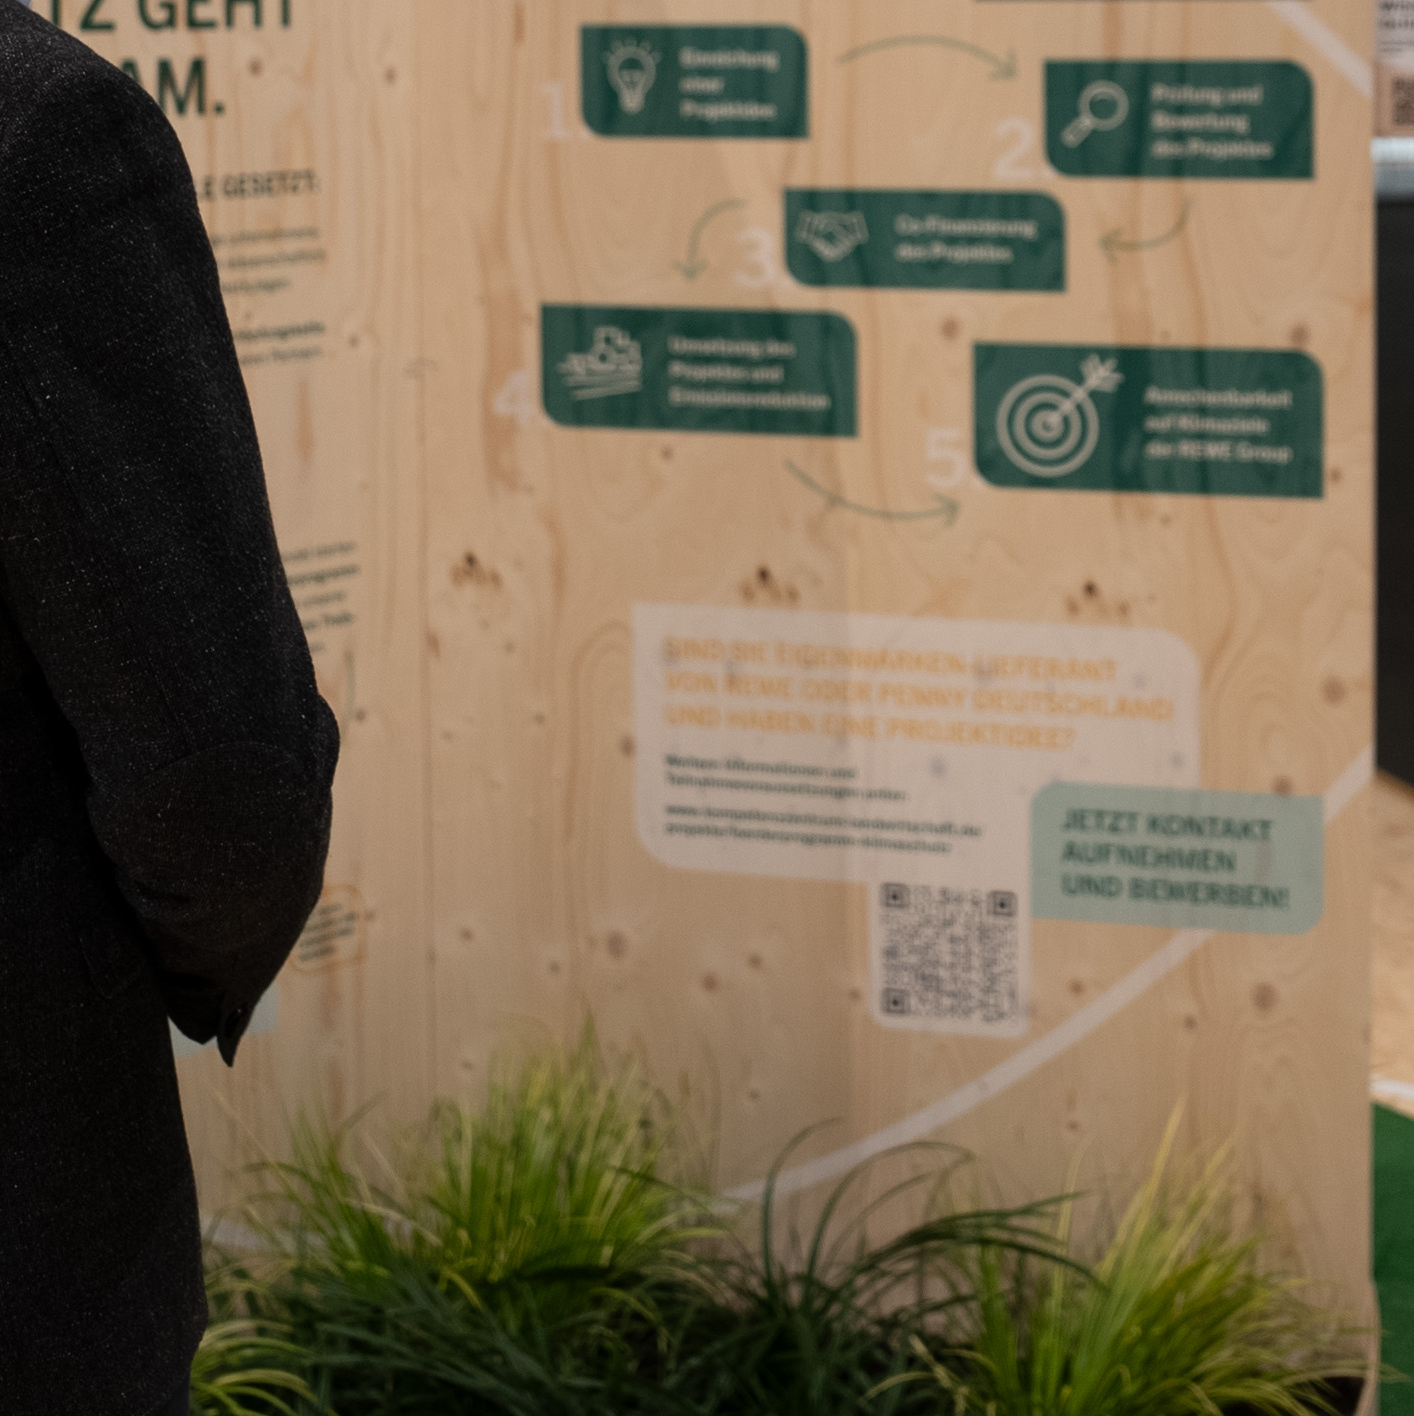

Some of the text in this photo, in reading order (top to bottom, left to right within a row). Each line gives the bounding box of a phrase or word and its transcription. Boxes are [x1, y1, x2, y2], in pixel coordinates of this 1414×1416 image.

[1226, 84, 1265, 106] und
[1177, 440, 1233, 461] REWE
[663, 670, 718, 694] VON
[723, 672, 792, 699] REWE
[800, 677, 872, 704] ODER
[876, 680, 965, 711] PENNY
[662, 704, 721, 729] UND
[725, 708, 816, 733] HABEN
[820, 712, 877, 739] EINE
[1062, 807, 1273, 842] JETZT KONTAKT
[1061, 839, 1236, 873] AUFNEHMEN
[1060, 873, 1124, 898] UND
